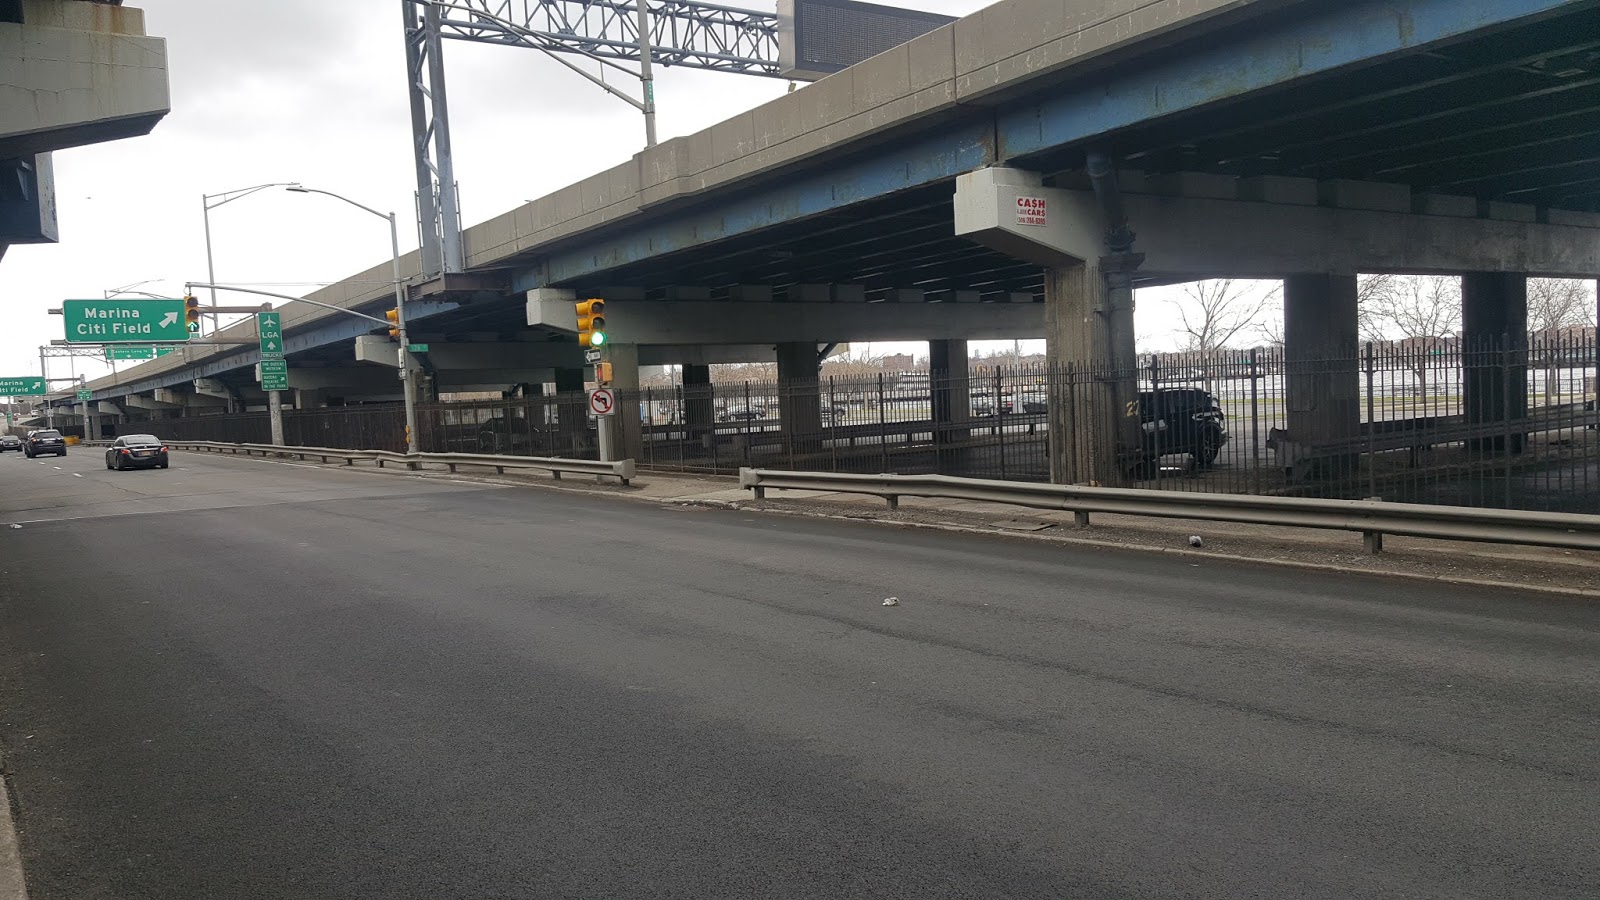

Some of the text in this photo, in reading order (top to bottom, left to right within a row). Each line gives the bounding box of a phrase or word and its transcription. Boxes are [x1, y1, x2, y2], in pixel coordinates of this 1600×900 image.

[1017, 198, 1045, 208] CA$H
[84, 308, 140, 318] Marina
[77, 322, 151, 334] Citi Field
